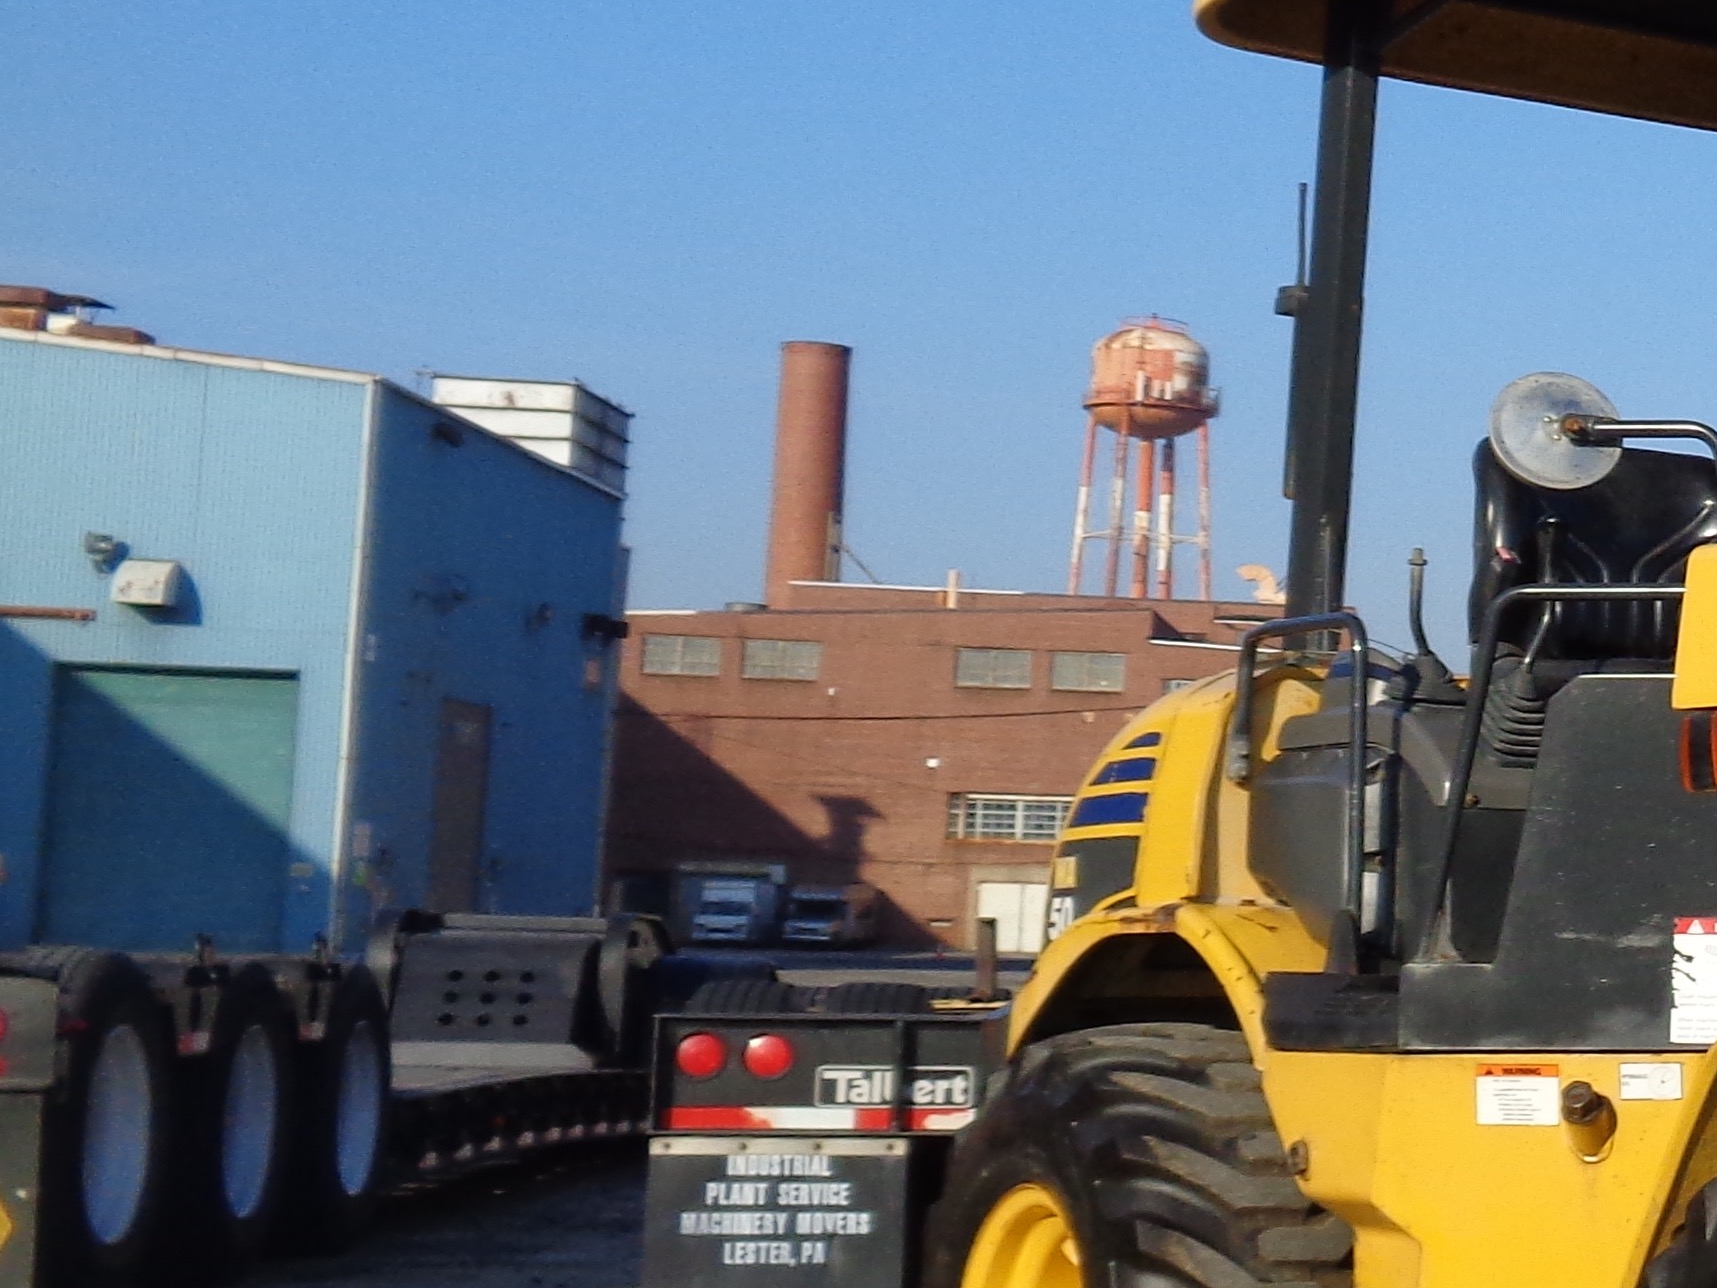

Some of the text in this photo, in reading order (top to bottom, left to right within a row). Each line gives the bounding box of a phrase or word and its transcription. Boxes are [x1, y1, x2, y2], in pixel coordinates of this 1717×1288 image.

[726, 1155, 833, 1177] INDUSTRIAL
[704, 1182, 851, 1206] PLANT SERVICE
[680, 1212, 872, 1235] MACHINERY MOVERS
[723, 1240, 827, 1267] LESTER, PA
